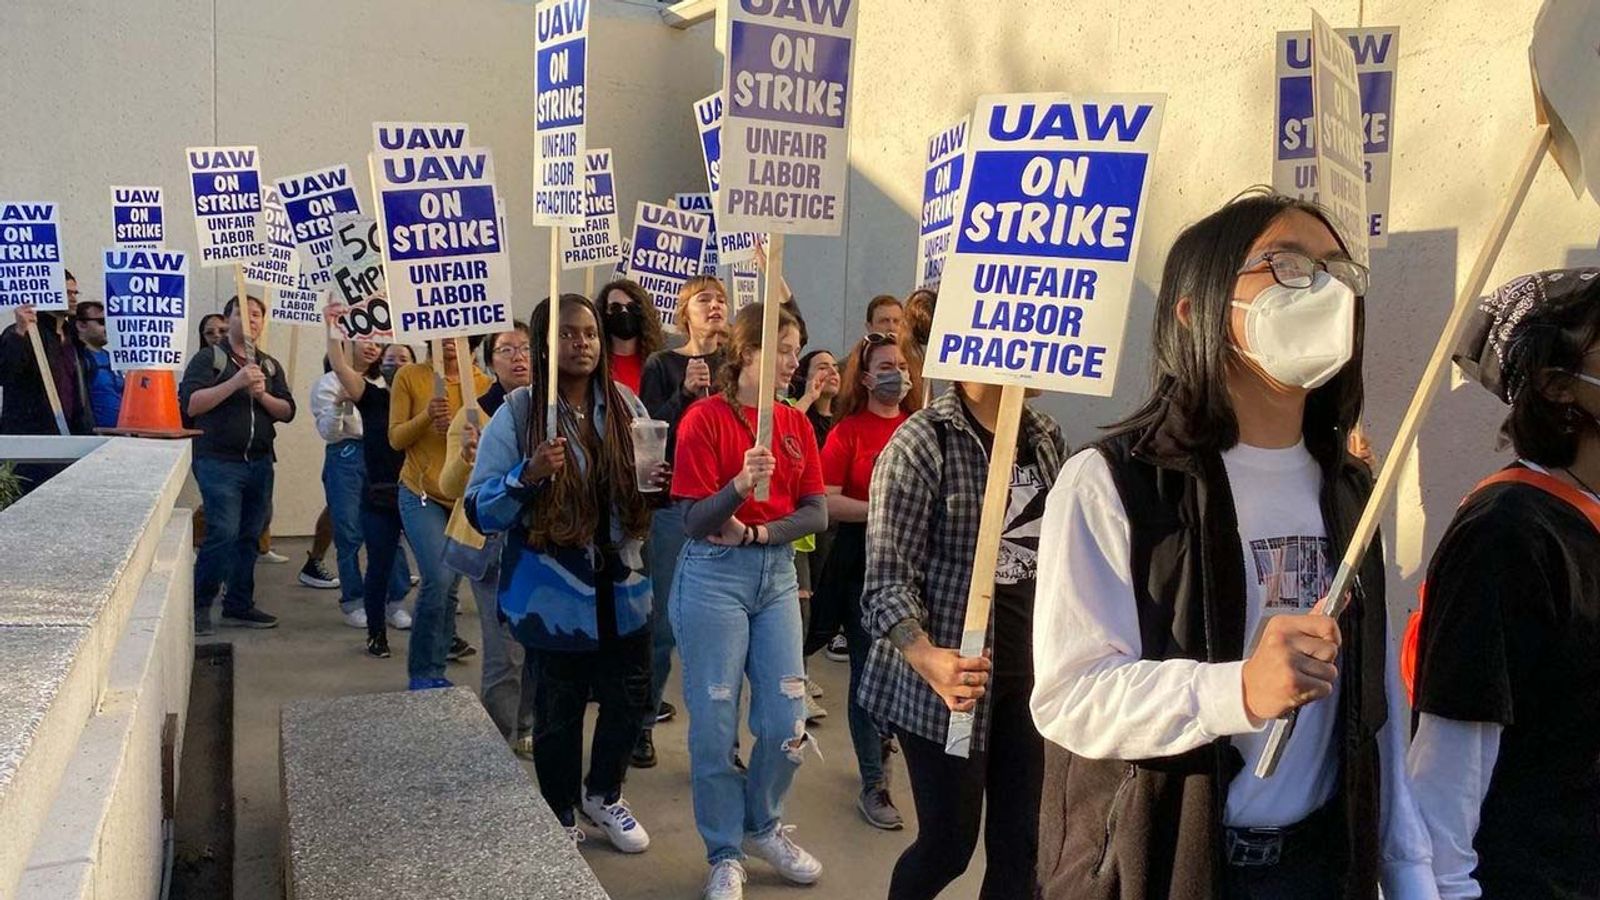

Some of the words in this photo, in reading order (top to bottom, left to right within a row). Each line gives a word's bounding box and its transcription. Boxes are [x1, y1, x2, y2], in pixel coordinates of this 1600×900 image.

[538, 0, 585, 43] UAW
[770, 33, 816, 73] ON
[1286, 34, 1392, 69] UW
[549, 48, 568, 84] ON
[538, 85, 583, 124] STRIKE
[734, 70, 844, 117] STRIKE
[699, 96, 722, 125] UA
[988, 104, 1153, 142] UAW
[1282, 113, 1386, 150] STKE
[379, 128, 464, 150] UAW
[542, 132, 576, 159] UNFAIR
[746, 127, 827, 159] UNFAIR
[929, 122, 966, 163] UAW
[190, 151, 255, 169] UAW
[384, 154, 486, 183] UAW
[213, 174, 239, 193] ON
[278, 168, 346, 198] UAW
[543, 162, 574, 187] LABOR
[749, 159, 821, 189] LABOR
[935, 163, 952, 194] ON
[1021, 156, 1089, 198] ON
[115, 190, 160, 203] UAW
[197, 193, 260, 212] STRIKE
[308, 195, 336, 216] ON
[419, 190, 462, 219] ON
[536, 190, 583, 215] PRACTICE
[679, 196, 713, 210] UA
[728, 189, 836, 220] PRACTICE
[2, 205, 53, 220] AW
[130, 207, 149, 222] ON
[208, 216, 255, 231] UNFAIR
[296, 210, 348, 239] STR
[642, 205, 705, 234] UAW
[3, 226, 34, 243] ON
[117, 224, 162, 239] STRIKE
[265, 224, 293, 246] RIK
[393, 220, 496, 253] STRIKE
[965, 202, 1132, 248] STRIKE
[212, 230, 254, 245] LABOR
[573, 231, 609, 247] LABOR
[656, 232, 684, 254] ON
[0, 244, 58, 261] TRIKE
[106, 251, 184, 271] UAW
[203, 243, 265, 261] PRACTICE
[268, 247, 292, 261] AIR
[565, 245, 619, 263] PRACTICE
[634, 248, 698, 276] STRIKE
[409, 260, 488, 284] UNFAIR
[924, 256, 947, 280] LABO
[0, 278, 50, 292] LABOR
[129, 276, 160, 294] ON
[973, 264, 1097, 300] UNFAIR
[0, 292, 64, 307] RACTICE
[108, 295, 183, 315] STRIKE
[279, 289, 318, 301] UNFAIR
[281, 300, 315, 312] LABOR
[416, 283, 486, 307] LABOR
[117, 318, 174, 334] UNFAIR
[272, 309, 322, 323] PRACTICE
[402, 304, 506, 332] PRACTICE
[971, 300, 1083, 338] LABOR
[120, 334, 171, 349] LABOR
[113, 350, 182, 364] PRACTICE
[939, 334, 1106, 379] PRACTICE
